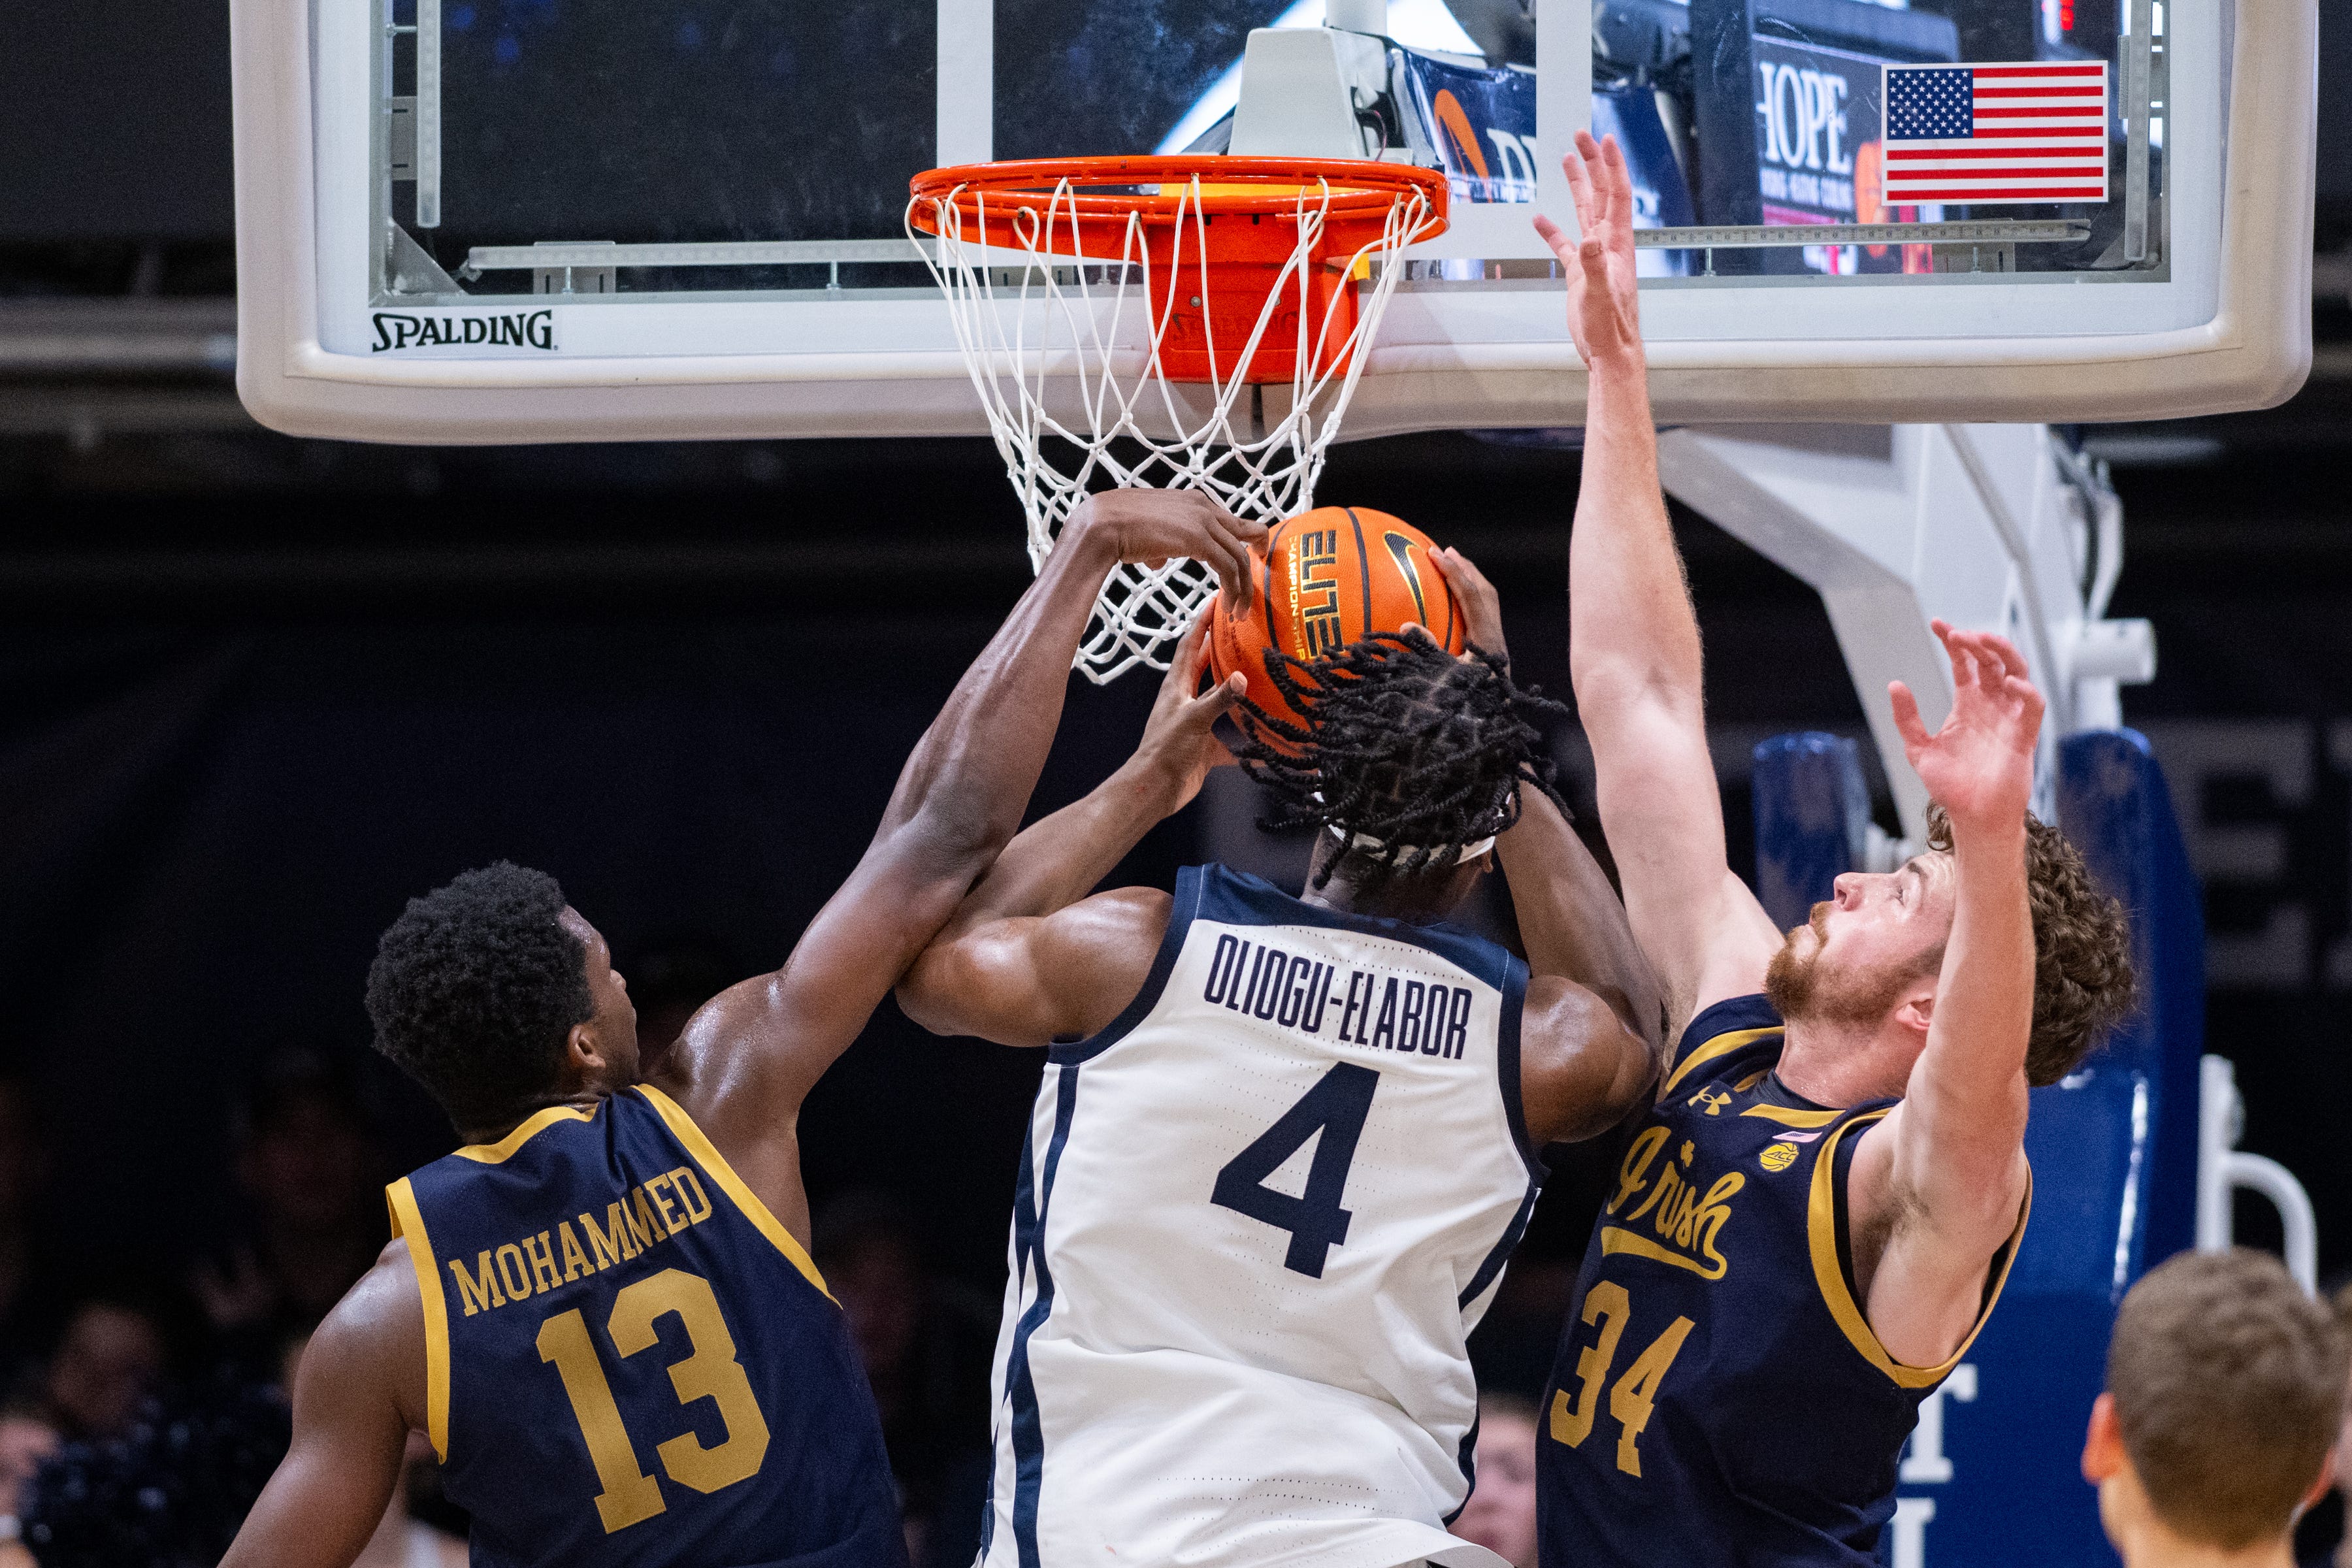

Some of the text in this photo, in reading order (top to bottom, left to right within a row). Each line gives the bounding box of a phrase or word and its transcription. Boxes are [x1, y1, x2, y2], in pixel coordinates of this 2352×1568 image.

[372, 310, 552, 352] SPALDING
[1300, 530, 1345, 660] ELITE
[1203, 934, 1473, 1060] OLIOGU-ELABOR
[1210, 1061, 1380, 1279] 4
[1602, 1126, 1745, 1277] Irish
[1765, 1151, 1797, 1161] ACC
[449, 1166, 713, 1317] MOHAMMED
[536, 1268, 770, 1534] 13
[1550, 1280, 1695, 1477] 34
